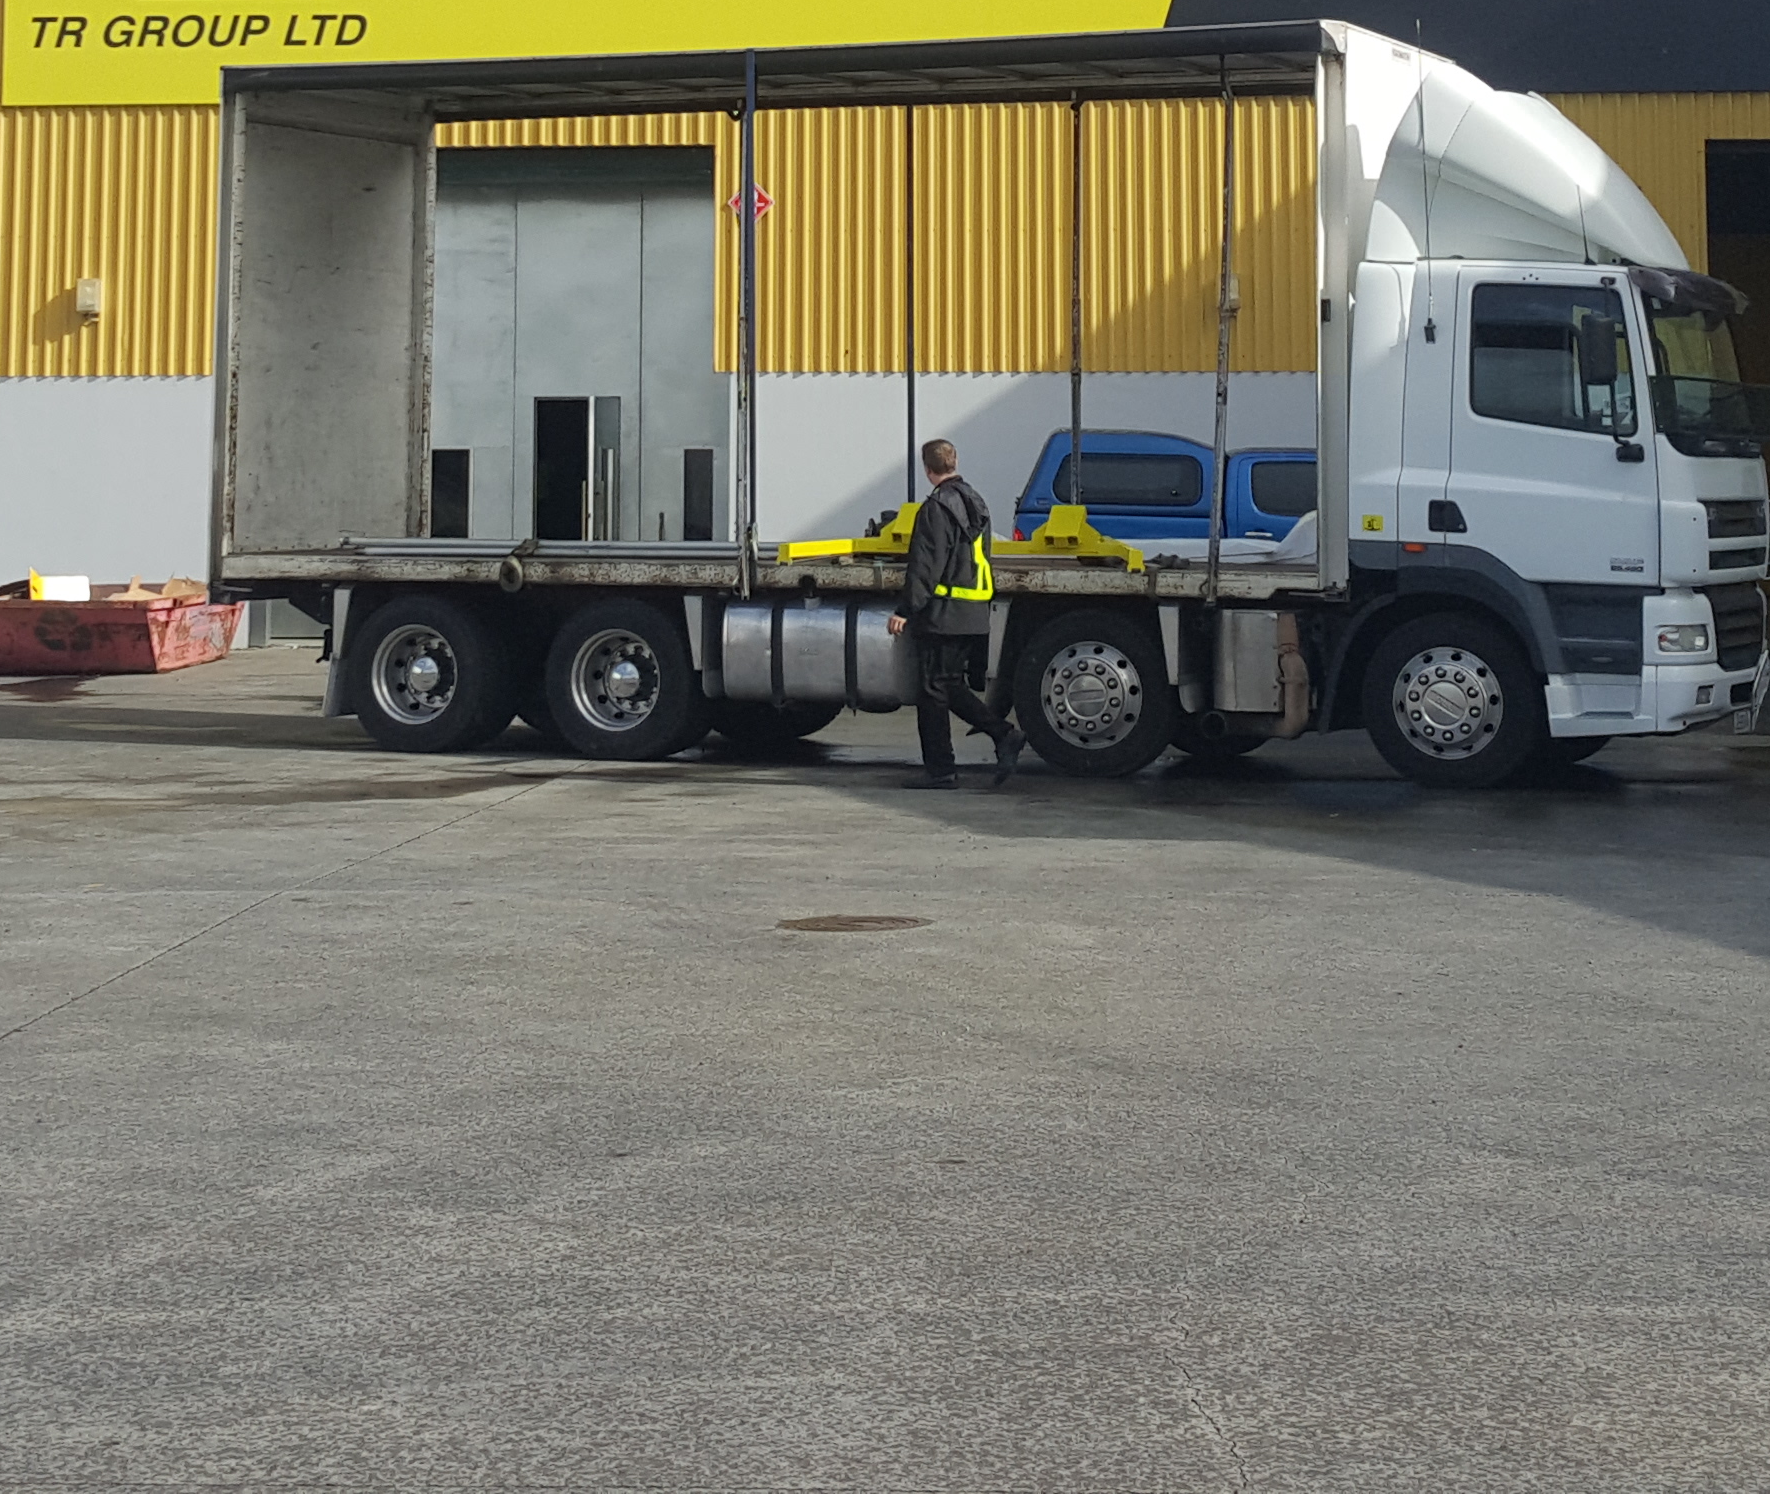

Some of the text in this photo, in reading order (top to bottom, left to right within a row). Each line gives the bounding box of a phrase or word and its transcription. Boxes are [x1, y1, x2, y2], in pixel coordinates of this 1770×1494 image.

[31, 14, 367, 48] TR GROUP LTD
